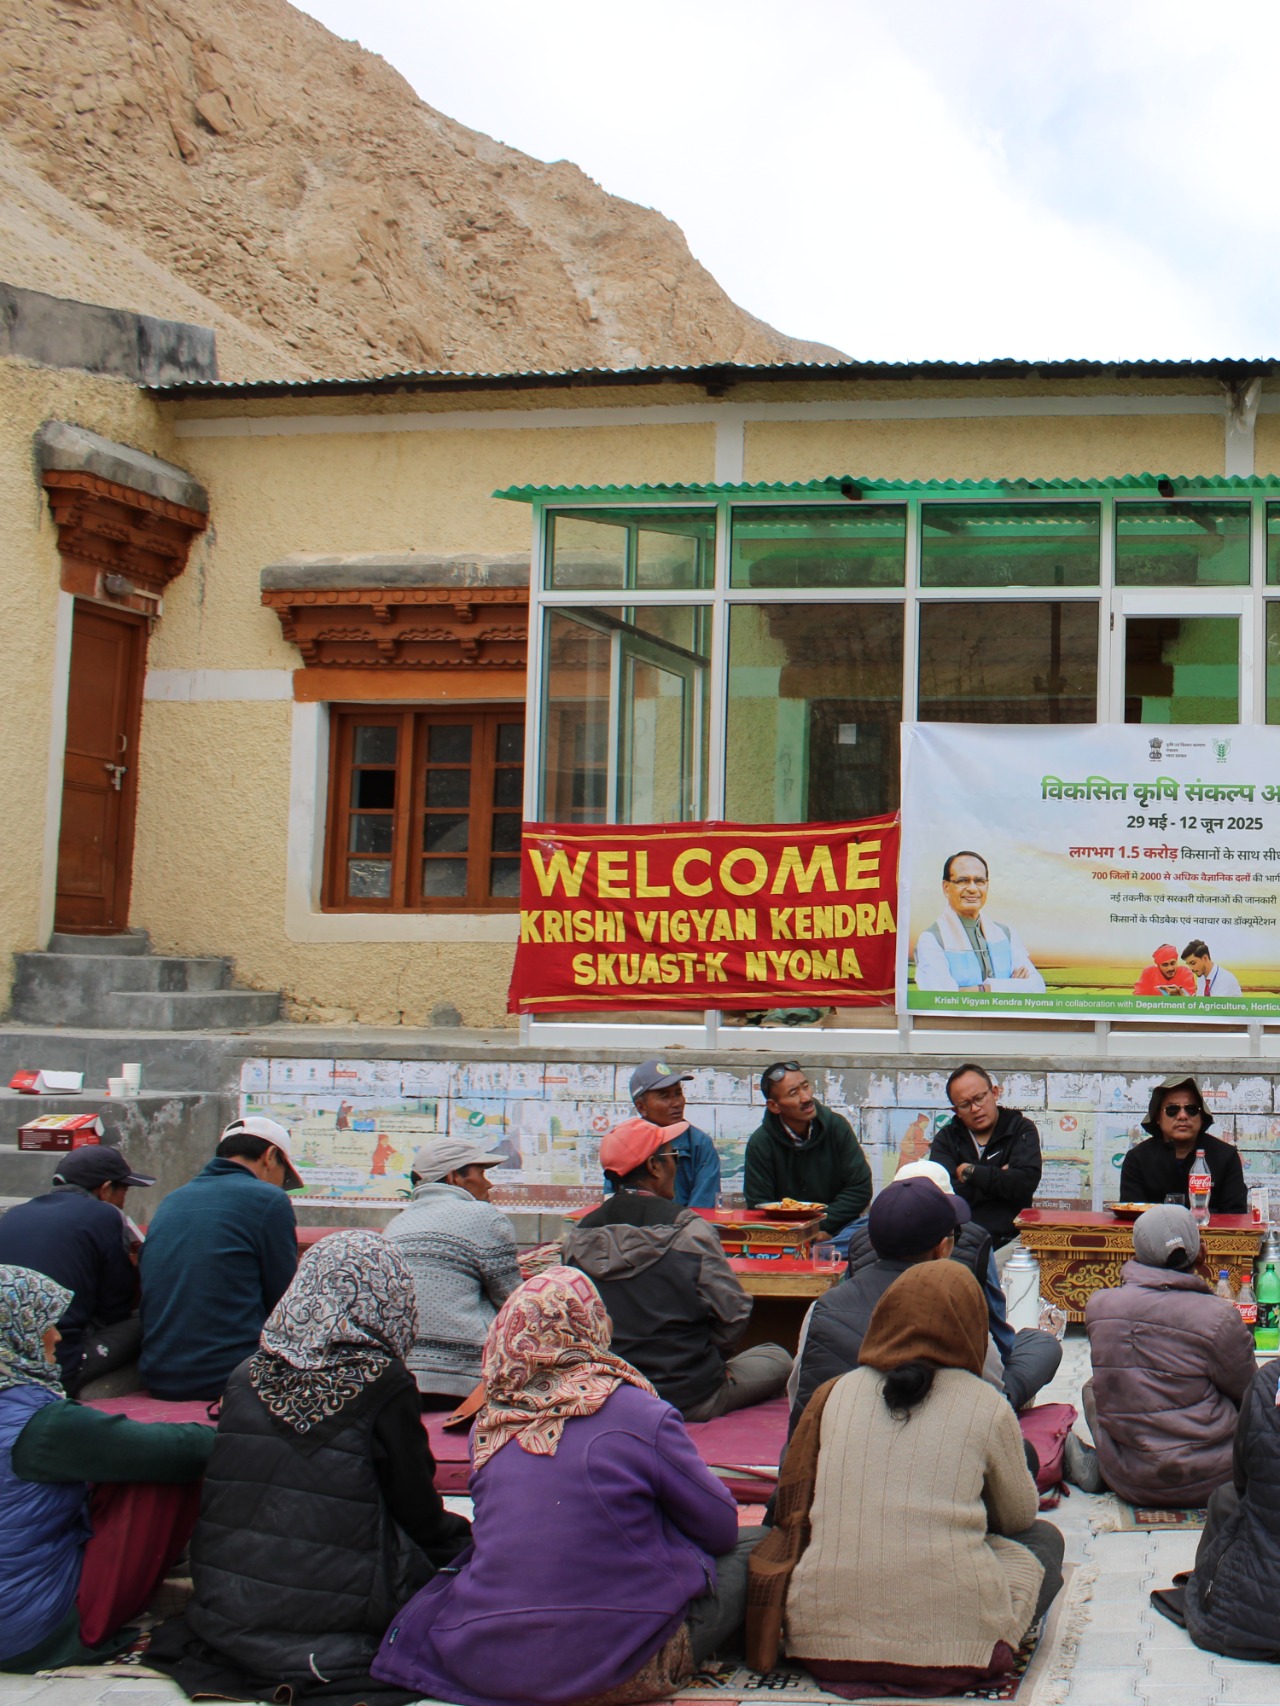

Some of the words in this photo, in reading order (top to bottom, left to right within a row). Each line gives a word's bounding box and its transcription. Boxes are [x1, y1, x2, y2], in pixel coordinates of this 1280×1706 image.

[1041, 775, 1129, 801] विकसित
[1133, 776, 1180, 808] कृषि
[1184, 777, 1256, 802] संकल्प
[1127, 815, 1145, 828] 29
[1148, 813, 1168, 831] मई
[1180, 816, 1197, 829] 12
[1200, 817, 1224, 834] जून
[1227, 817, 1263, 830] 2025
[1069, 846, 1115, 858] लगभग
[1118, 846, 1140, 859] 1.5
[1143, 844, 1178, 862] करोड़
[1181, 845, 1220, 860] किसानों
[1223, 846, 1234, 860] के
[1237, 850, 1260, 861] साथ
[528, 839, 882, 898] WELCOME
[1092, 872, 1108, 880] 700
[1110, 870, 1130, 880] जिलों
[1140, 872, 1161, 880] 2000
[1164, 871, 1171, 880] से
[1173, 871, 1199, 881] अधिक
[1201, 872, 1233, 882] वैज्ञानिक
[1235, 872, 1251, 882] दलों
[1252, 872, 1262, 882] की
[1110, 892, 1120, 902] नई
[1122, 892, 1152, 902] तकनीक
[1154, 894, 1164, 902] एवं
[1166, 894, 1194, 903] सरकारी
[1196, 894, 1230, 904] योजनाओं
[1232, 894, 1243, 904] की
[1244, 894, 1277, 904] जानकारी
[520, 909, 627, 944] KRISHI
[635, 907, 757, 943] VIGYAN
[770, 900, 898, 941] KENDRA
[1110, 913, 1138, 924] किसानों
[1140, 914, 1148, 924] के
[1149, 914, 1178, 924] फीडबैक
[1180, 915, 1192, 925] एवं
[1193, 916, 1220, 925] नवाचार
[1222, 917, 1232, 926] का
[572, 952, 729, 986] SKUAST-K
[745, 948, 864, 982] NYOMA
[934, 996, 959, 1005] Krishi
[961, 997, 990, 1008] Vigyan
[992, 997, 1023, 1006] Kendra
[1025, 998, 1054, 1008] Nyoma
[1056, 999, 1063, 1007] in
[1065, 1000, 1116, 1008] collaboration
[1118, 1000, 1134, 1008] with
[1136, 1000, 1186, 1010] Department
[1188, 1001, 1197, 1010] of
[1198, 1002, 1249, 1012] Agriculture,
